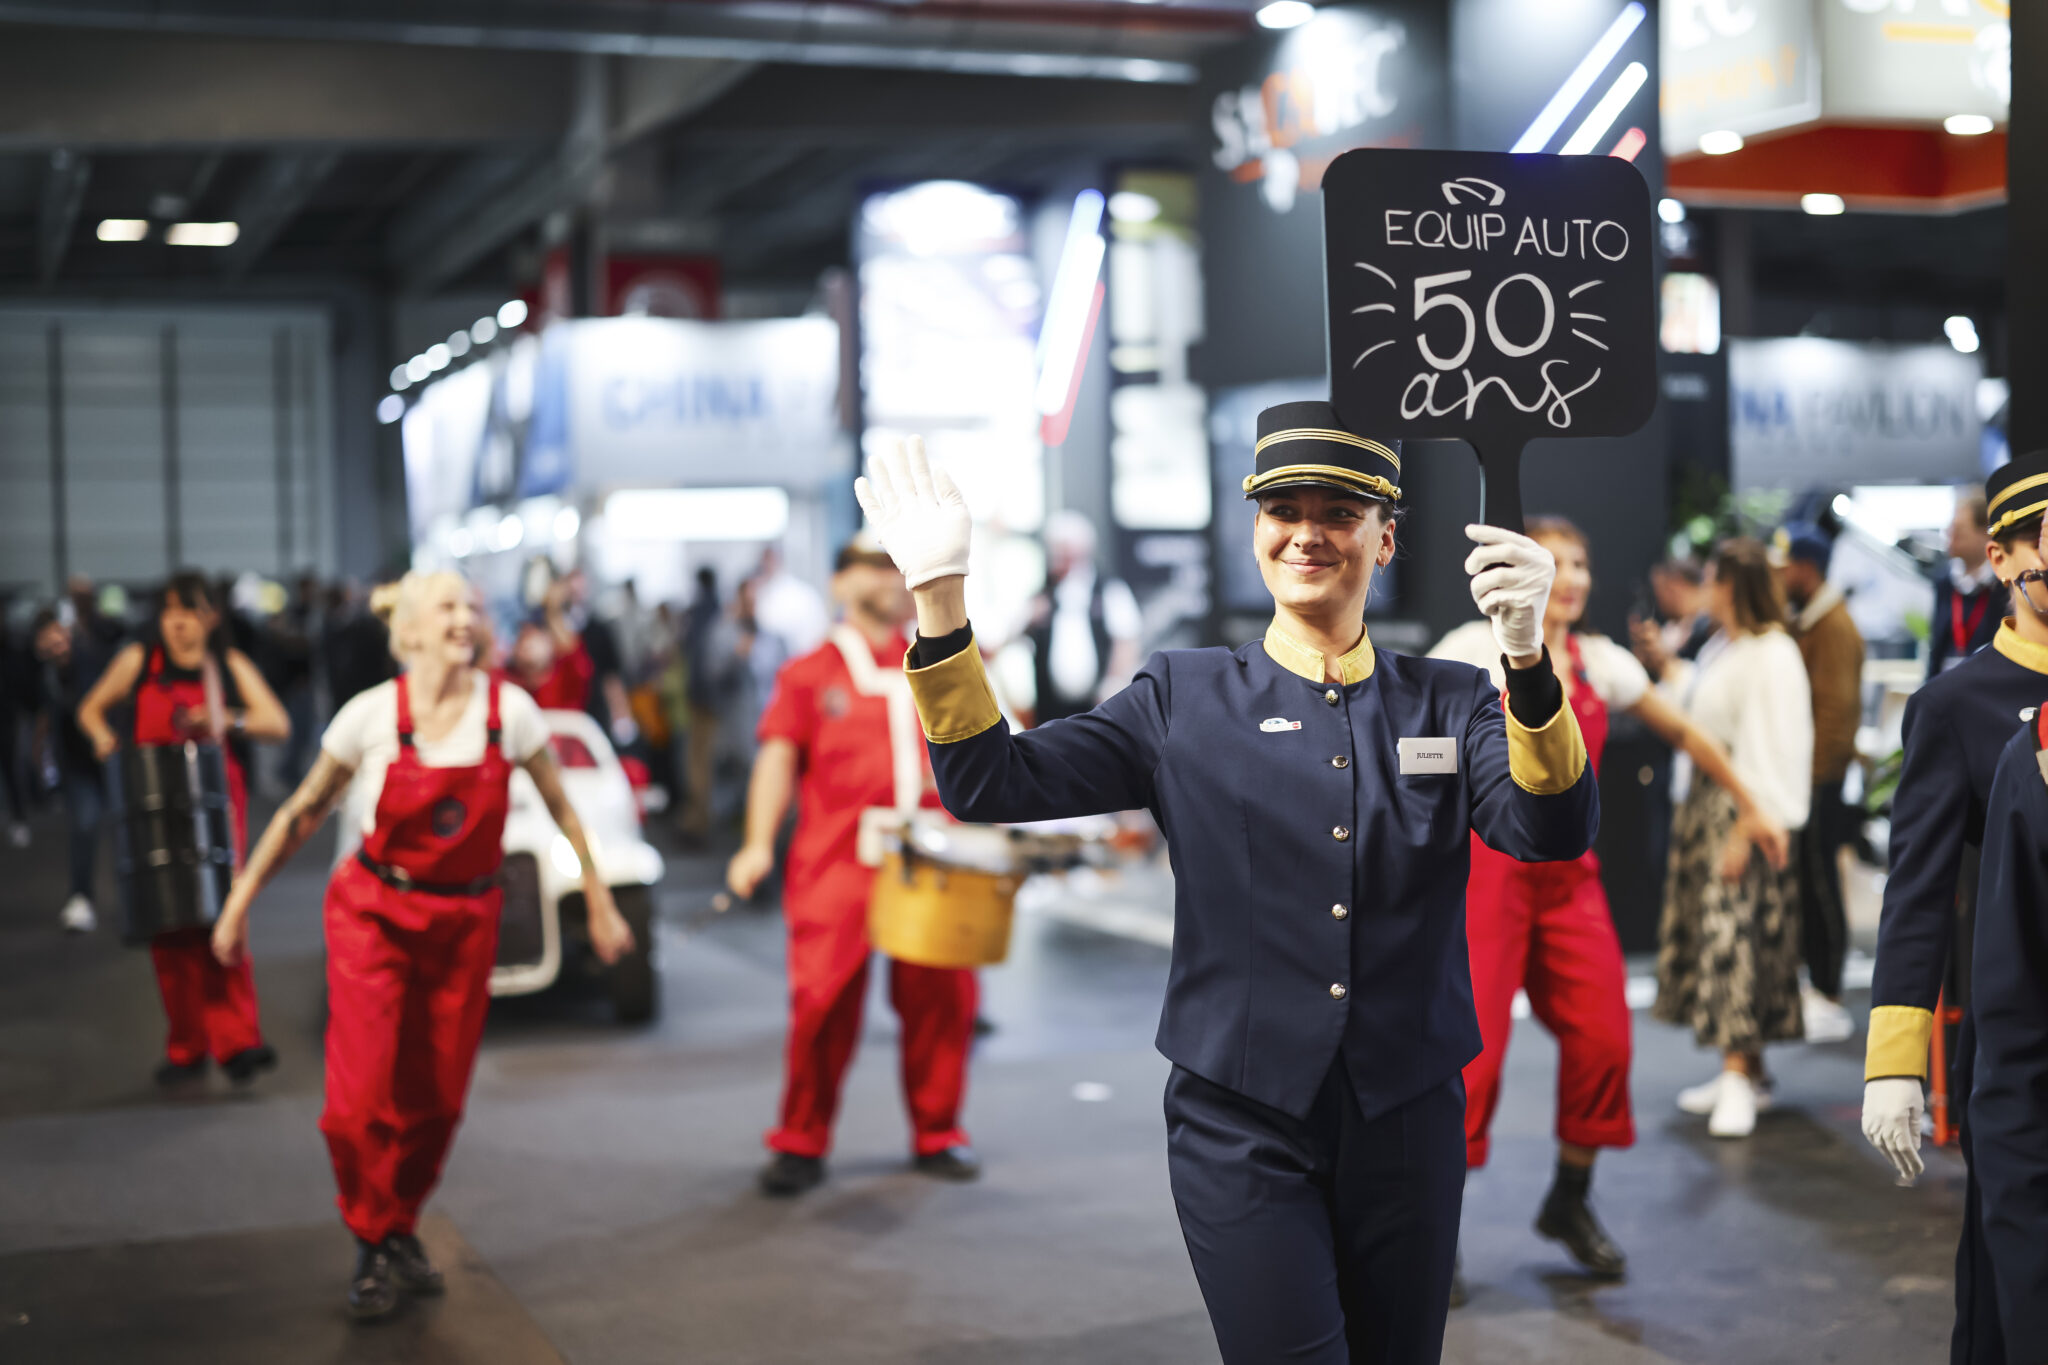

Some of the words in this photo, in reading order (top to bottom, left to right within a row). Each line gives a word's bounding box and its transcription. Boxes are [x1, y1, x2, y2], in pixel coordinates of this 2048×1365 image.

[1385, 210, 1506, 252] EQUIP
[1514, 216, 1629, 261] AUTO
[1414, 270, 1556, 371] 50
[1400, 360, 1602, 428] ans
[1416, 752, 1444, 760] JULIETTE
